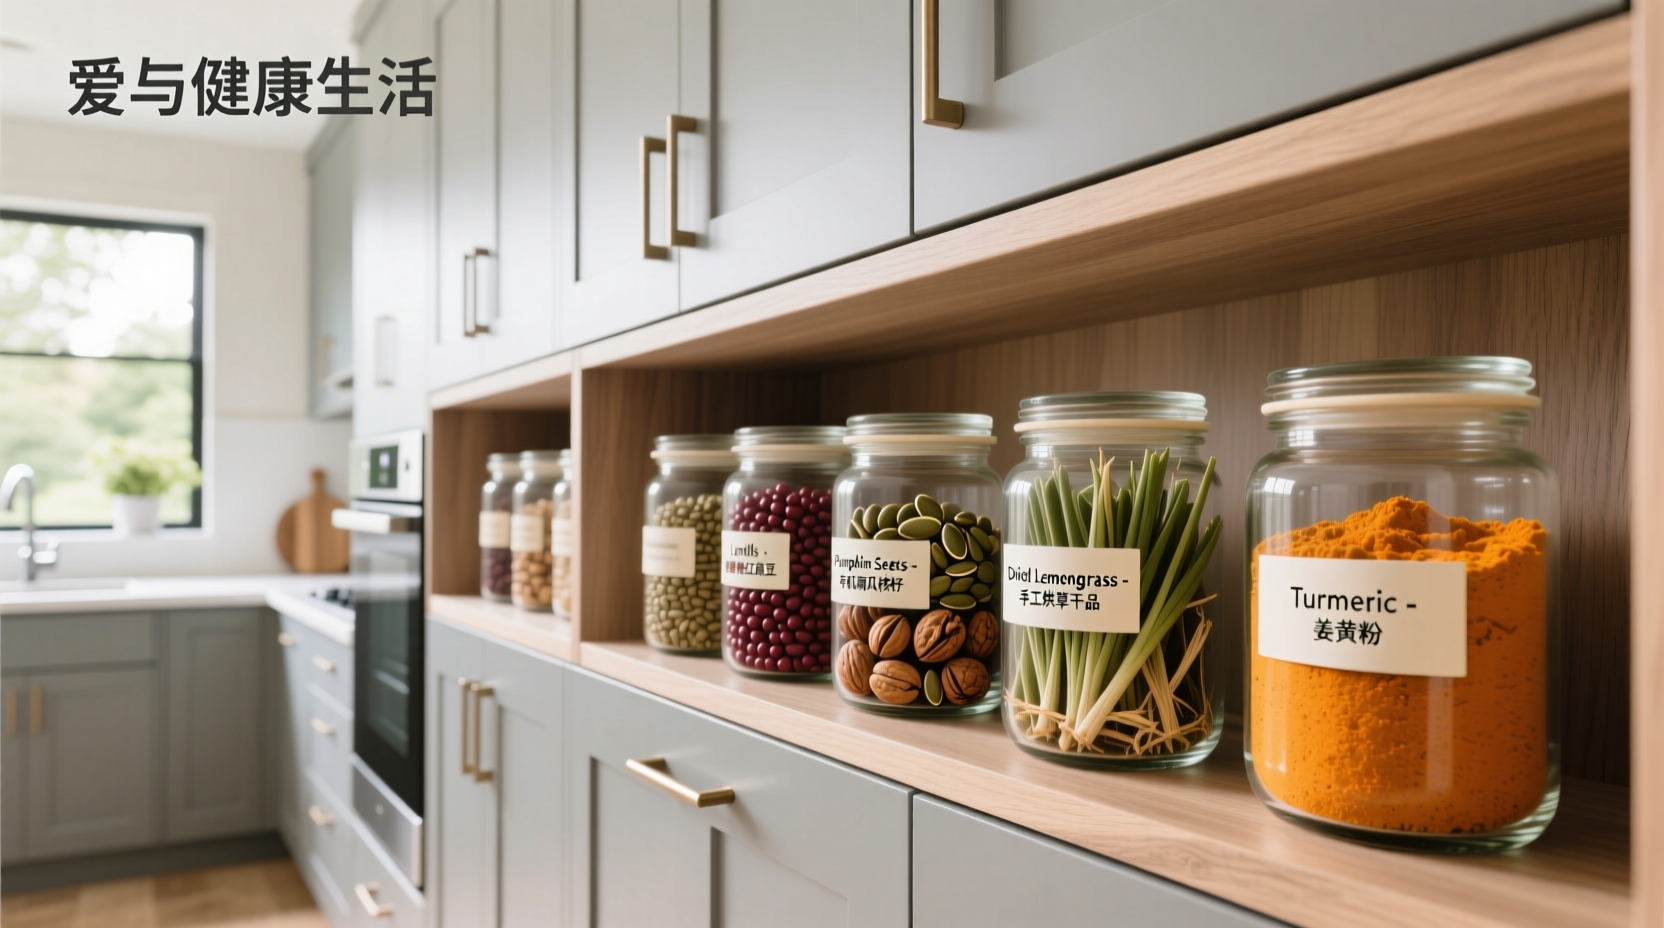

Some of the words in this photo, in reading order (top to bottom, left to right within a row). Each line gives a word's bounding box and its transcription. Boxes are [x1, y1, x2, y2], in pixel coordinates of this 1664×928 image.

[1290, 586, 1397, 614] Turmeric
[1313, 617, 1383, 646] 姜黄粉
